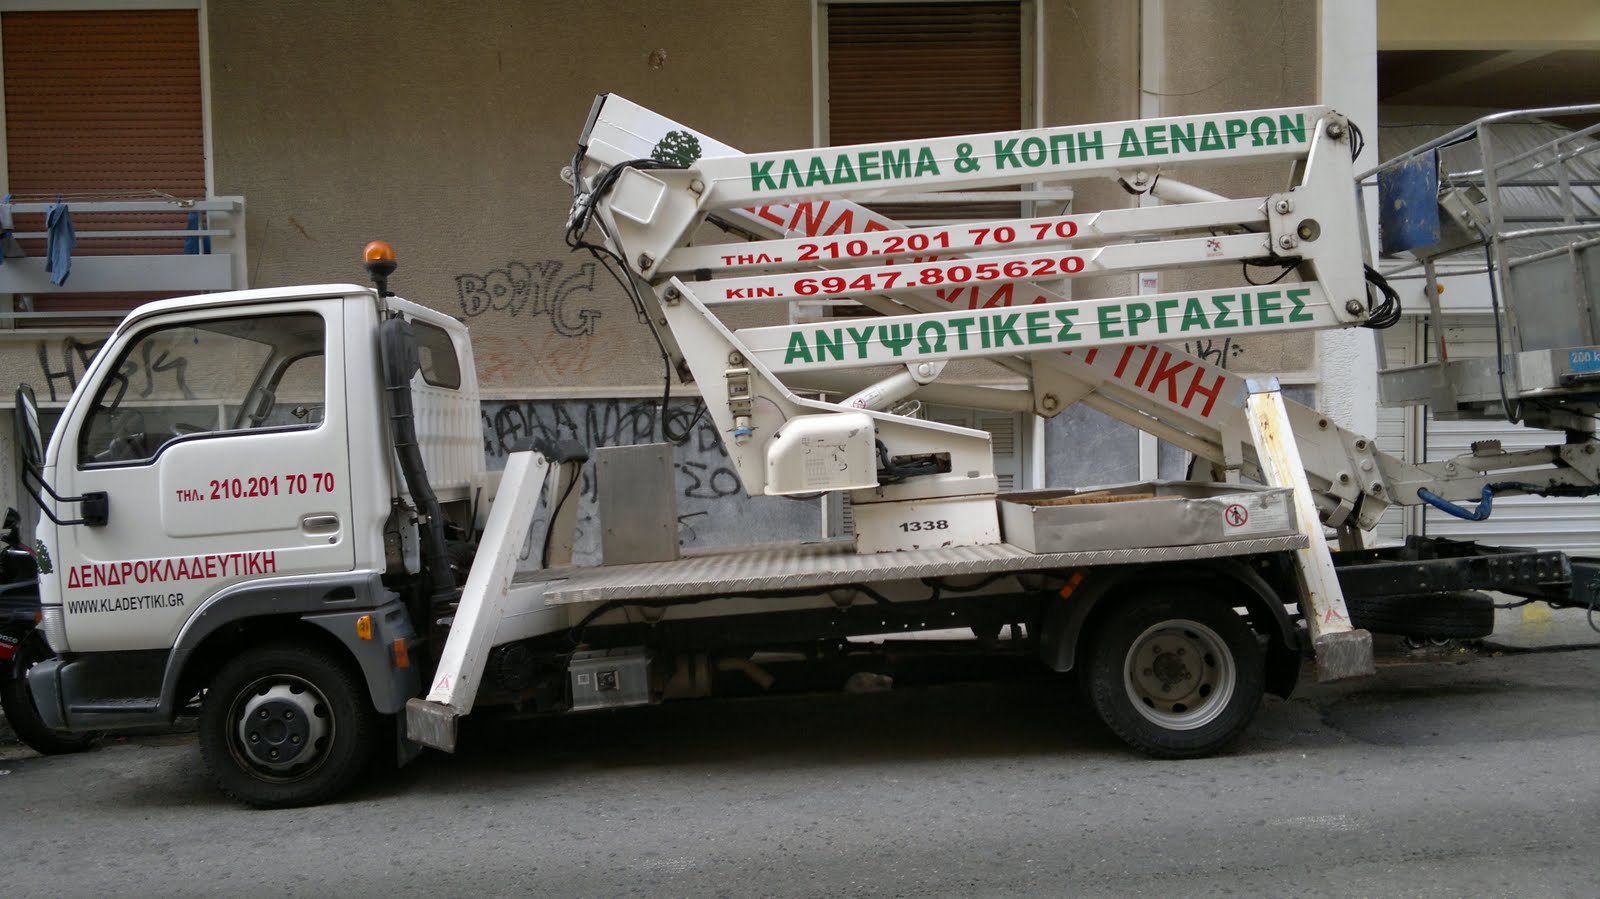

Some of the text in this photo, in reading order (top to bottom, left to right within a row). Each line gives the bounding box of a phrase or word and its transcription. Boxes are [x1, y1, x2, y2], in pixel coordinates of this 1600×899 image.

[750, 113, 1307, 191] ΚΛΑΔΕΜΑ & ΚΟΠΗ ΔΕΝΔΡΩΝ
[721, 221, 1079, 266] ΤΗΛ. 210.201 70 70
[792, 256, 1086, 296] 6947.805620
[784, 289, 1314, 364] ΑΝΥΨΩΤΙΚΕΣ ΕΡΓΑΣΙΕΣ
[176, 472, 335, 502] ΤΗΛ. 210.201 70 70
[899, 519, 949, 533] 1338
[67, 551, 277, 589] ΔΕΝΔΡΟΚΛΑΔΕΥΤΙΚΗ
[68, 593, 185, 615] WWW.KLADEYTIKI.GR
